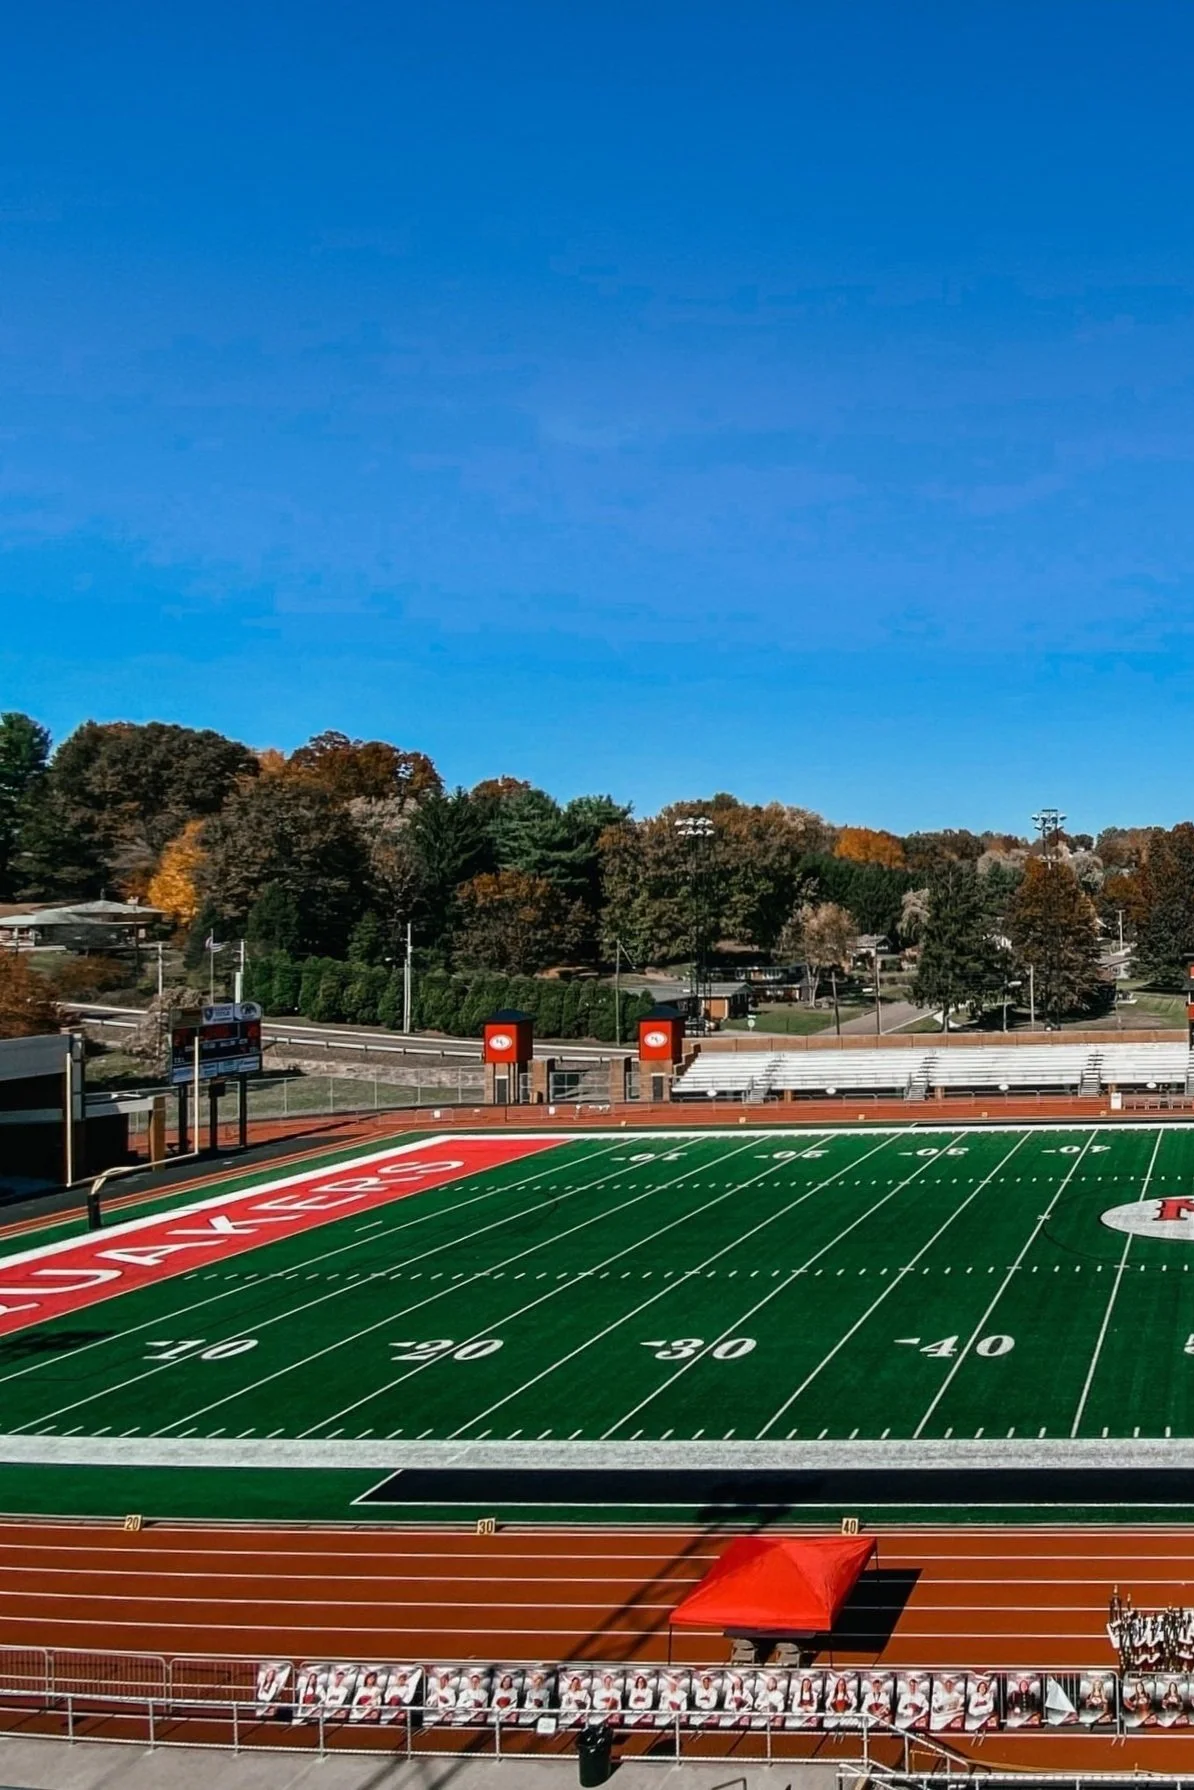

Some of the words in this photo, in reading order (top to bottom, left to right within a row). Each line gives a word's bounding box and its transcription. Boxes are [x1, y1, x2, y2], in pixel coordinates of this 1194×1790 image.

[629, 1152, 688, 1162] 10
[772, 1150, 830, 1160] 20
[916, 1147, 970, 1157] 30
[1059, 1144, 1112, 1154] 40
[142, 1338, 259, 1361] 10
[390, 1339, 505, 1361] 20
[654, 1337, 757, 1360] 30
[919, 1334, 1015, 1358] 40
[125, 1516, 139, 1531] 20
[479, 1519, 494, 1535] 30
[843, 1519, 857, 1535] 40
